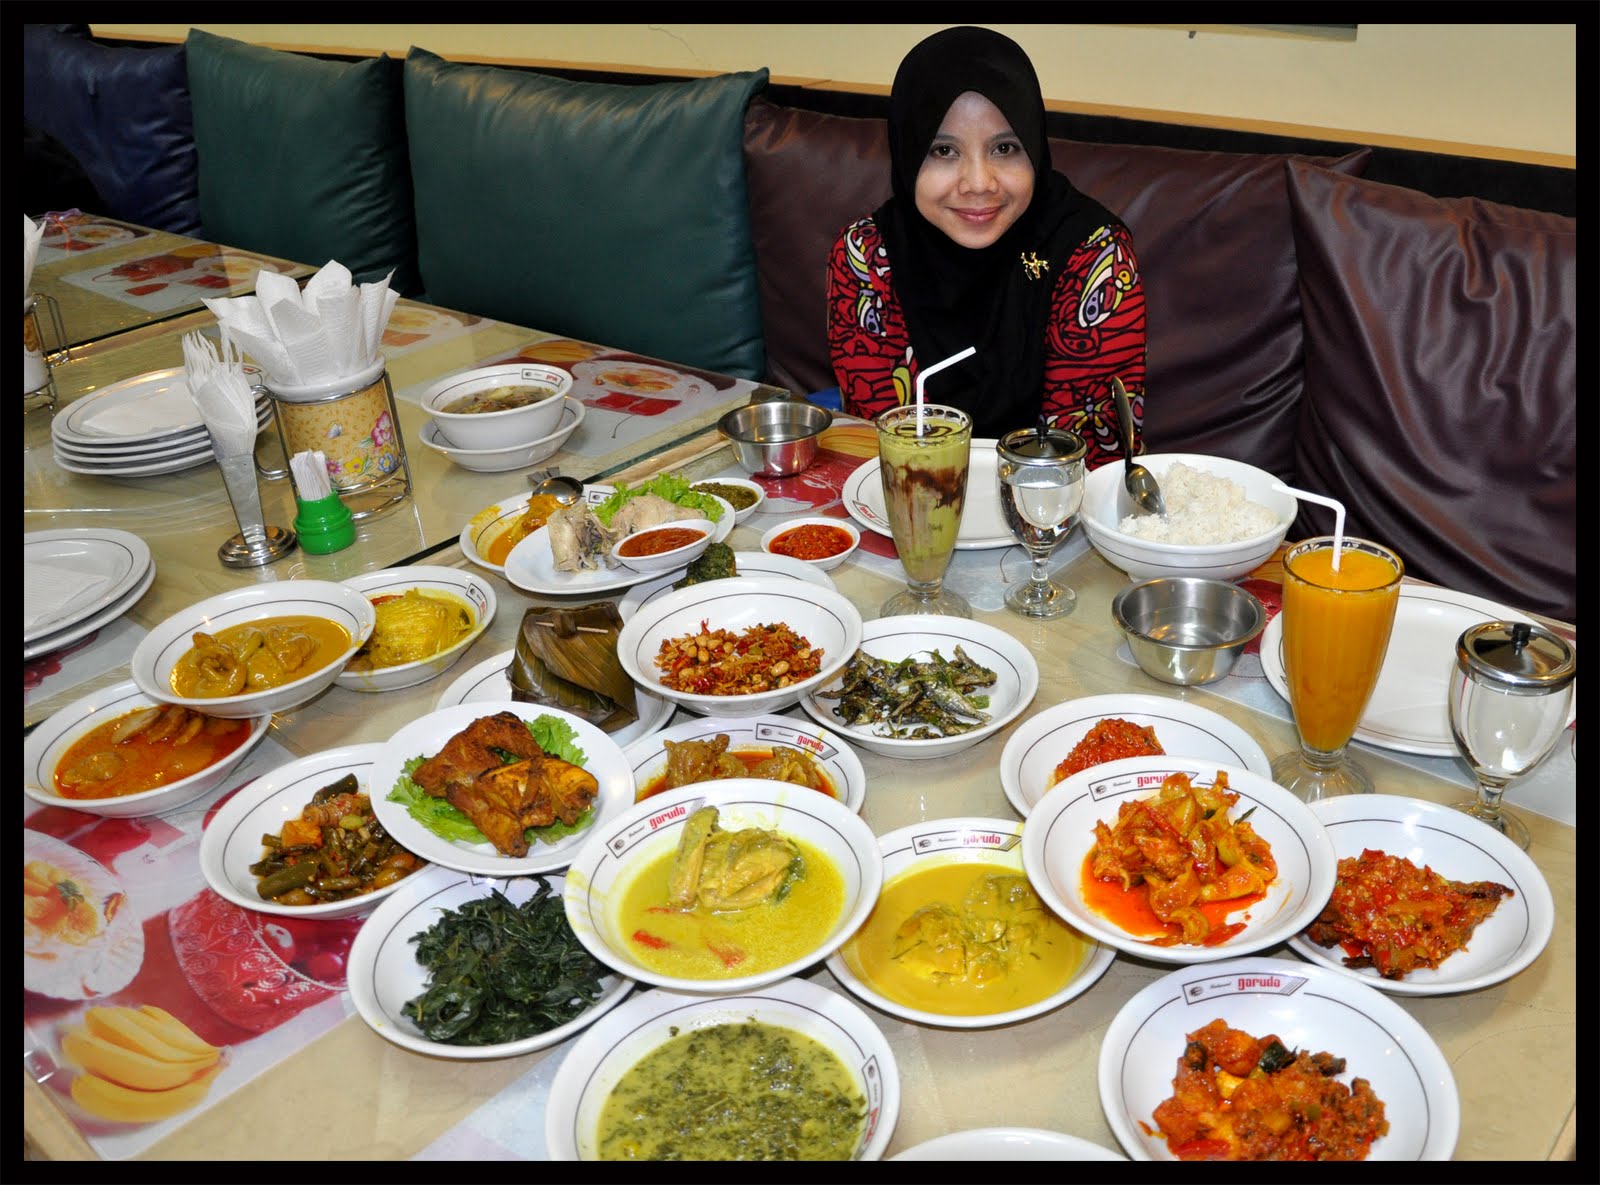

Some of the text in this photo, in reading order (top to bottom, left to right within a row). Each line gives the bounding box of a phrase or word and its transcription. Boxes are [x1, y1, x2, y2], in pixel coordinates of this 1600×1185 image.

[796, 735, 825, 752] garuda
[1137, 773, 1168, 787] garu
[649, 806, 686, 830] garuda
[1238, 976, 1280, 990] garuda
